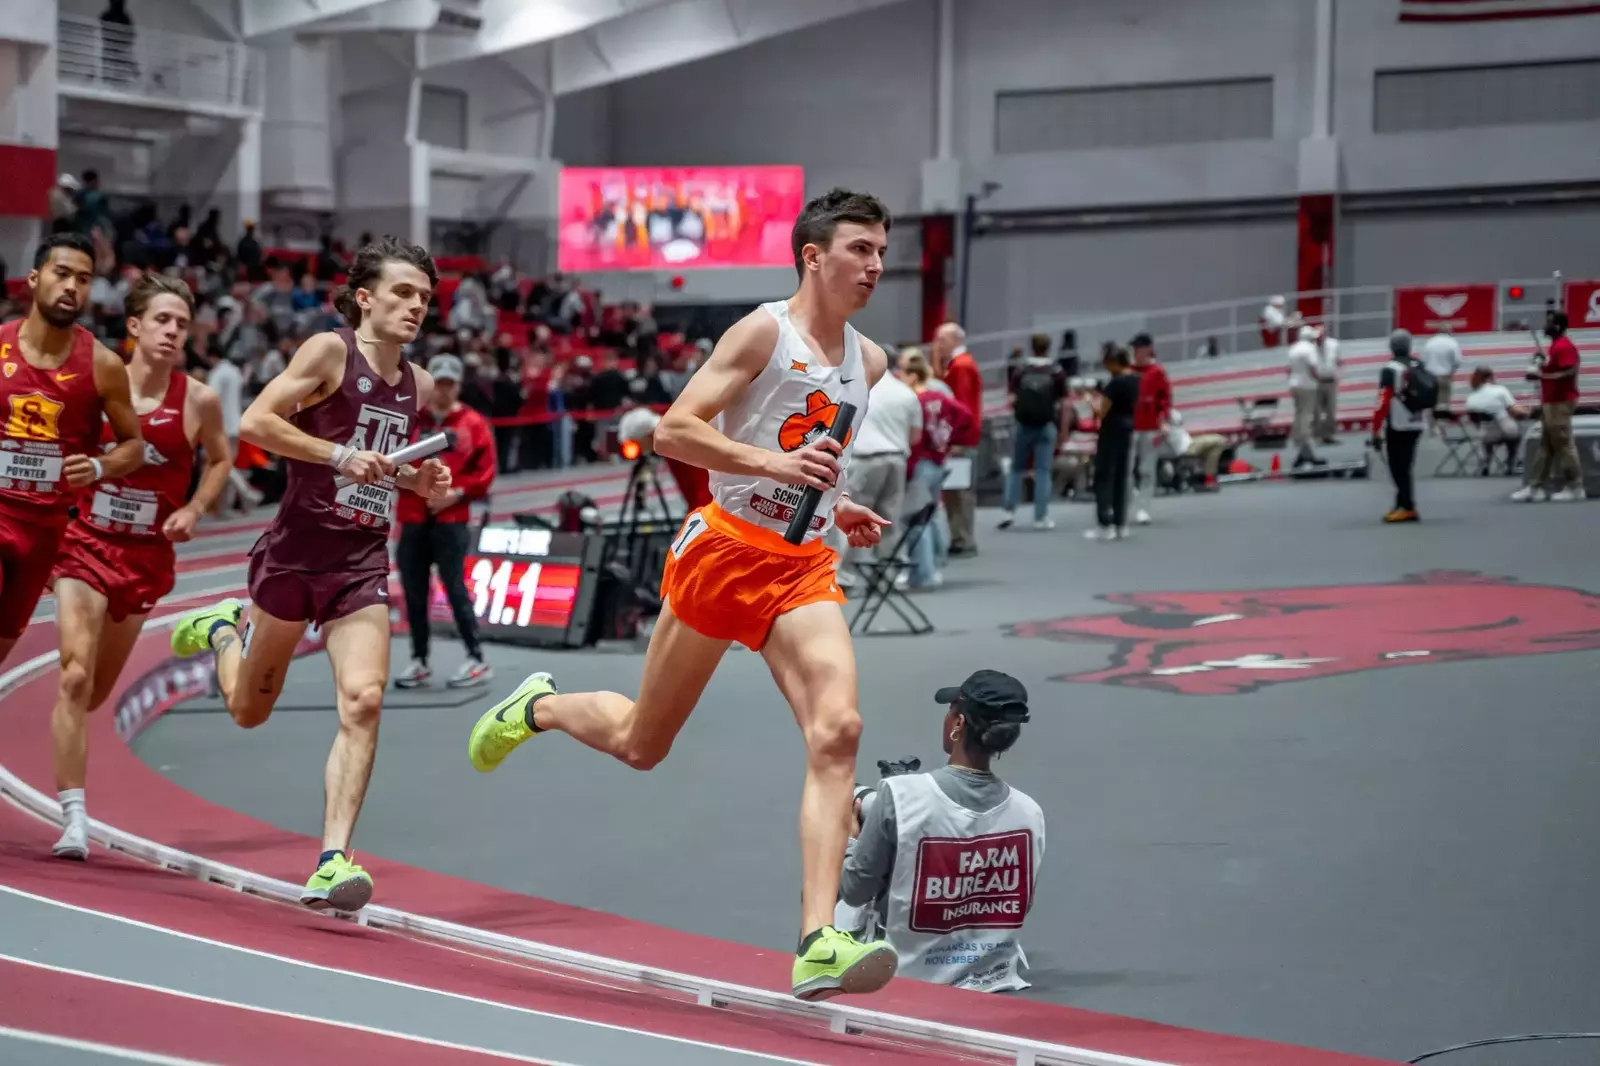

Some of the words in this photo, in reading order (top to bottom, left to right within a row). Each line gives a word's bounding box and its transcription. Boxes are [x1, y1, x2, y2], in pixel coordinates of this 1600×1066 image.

[12, 454, 45, 468] BOBBY
[6, 465, 47, 480] POYNTER
[356, 484, 388, 502] COOPER
[772, 487, 802, 506] SCHO
[959, 844, 1019, 874] FARM
[925, 868, 1020, 900] BUREAU
[942, 900, 1021, 921] INSURANCE
[980, 943, 993, 952] VS
[924, 955, 980, 966] NOVEMBER
